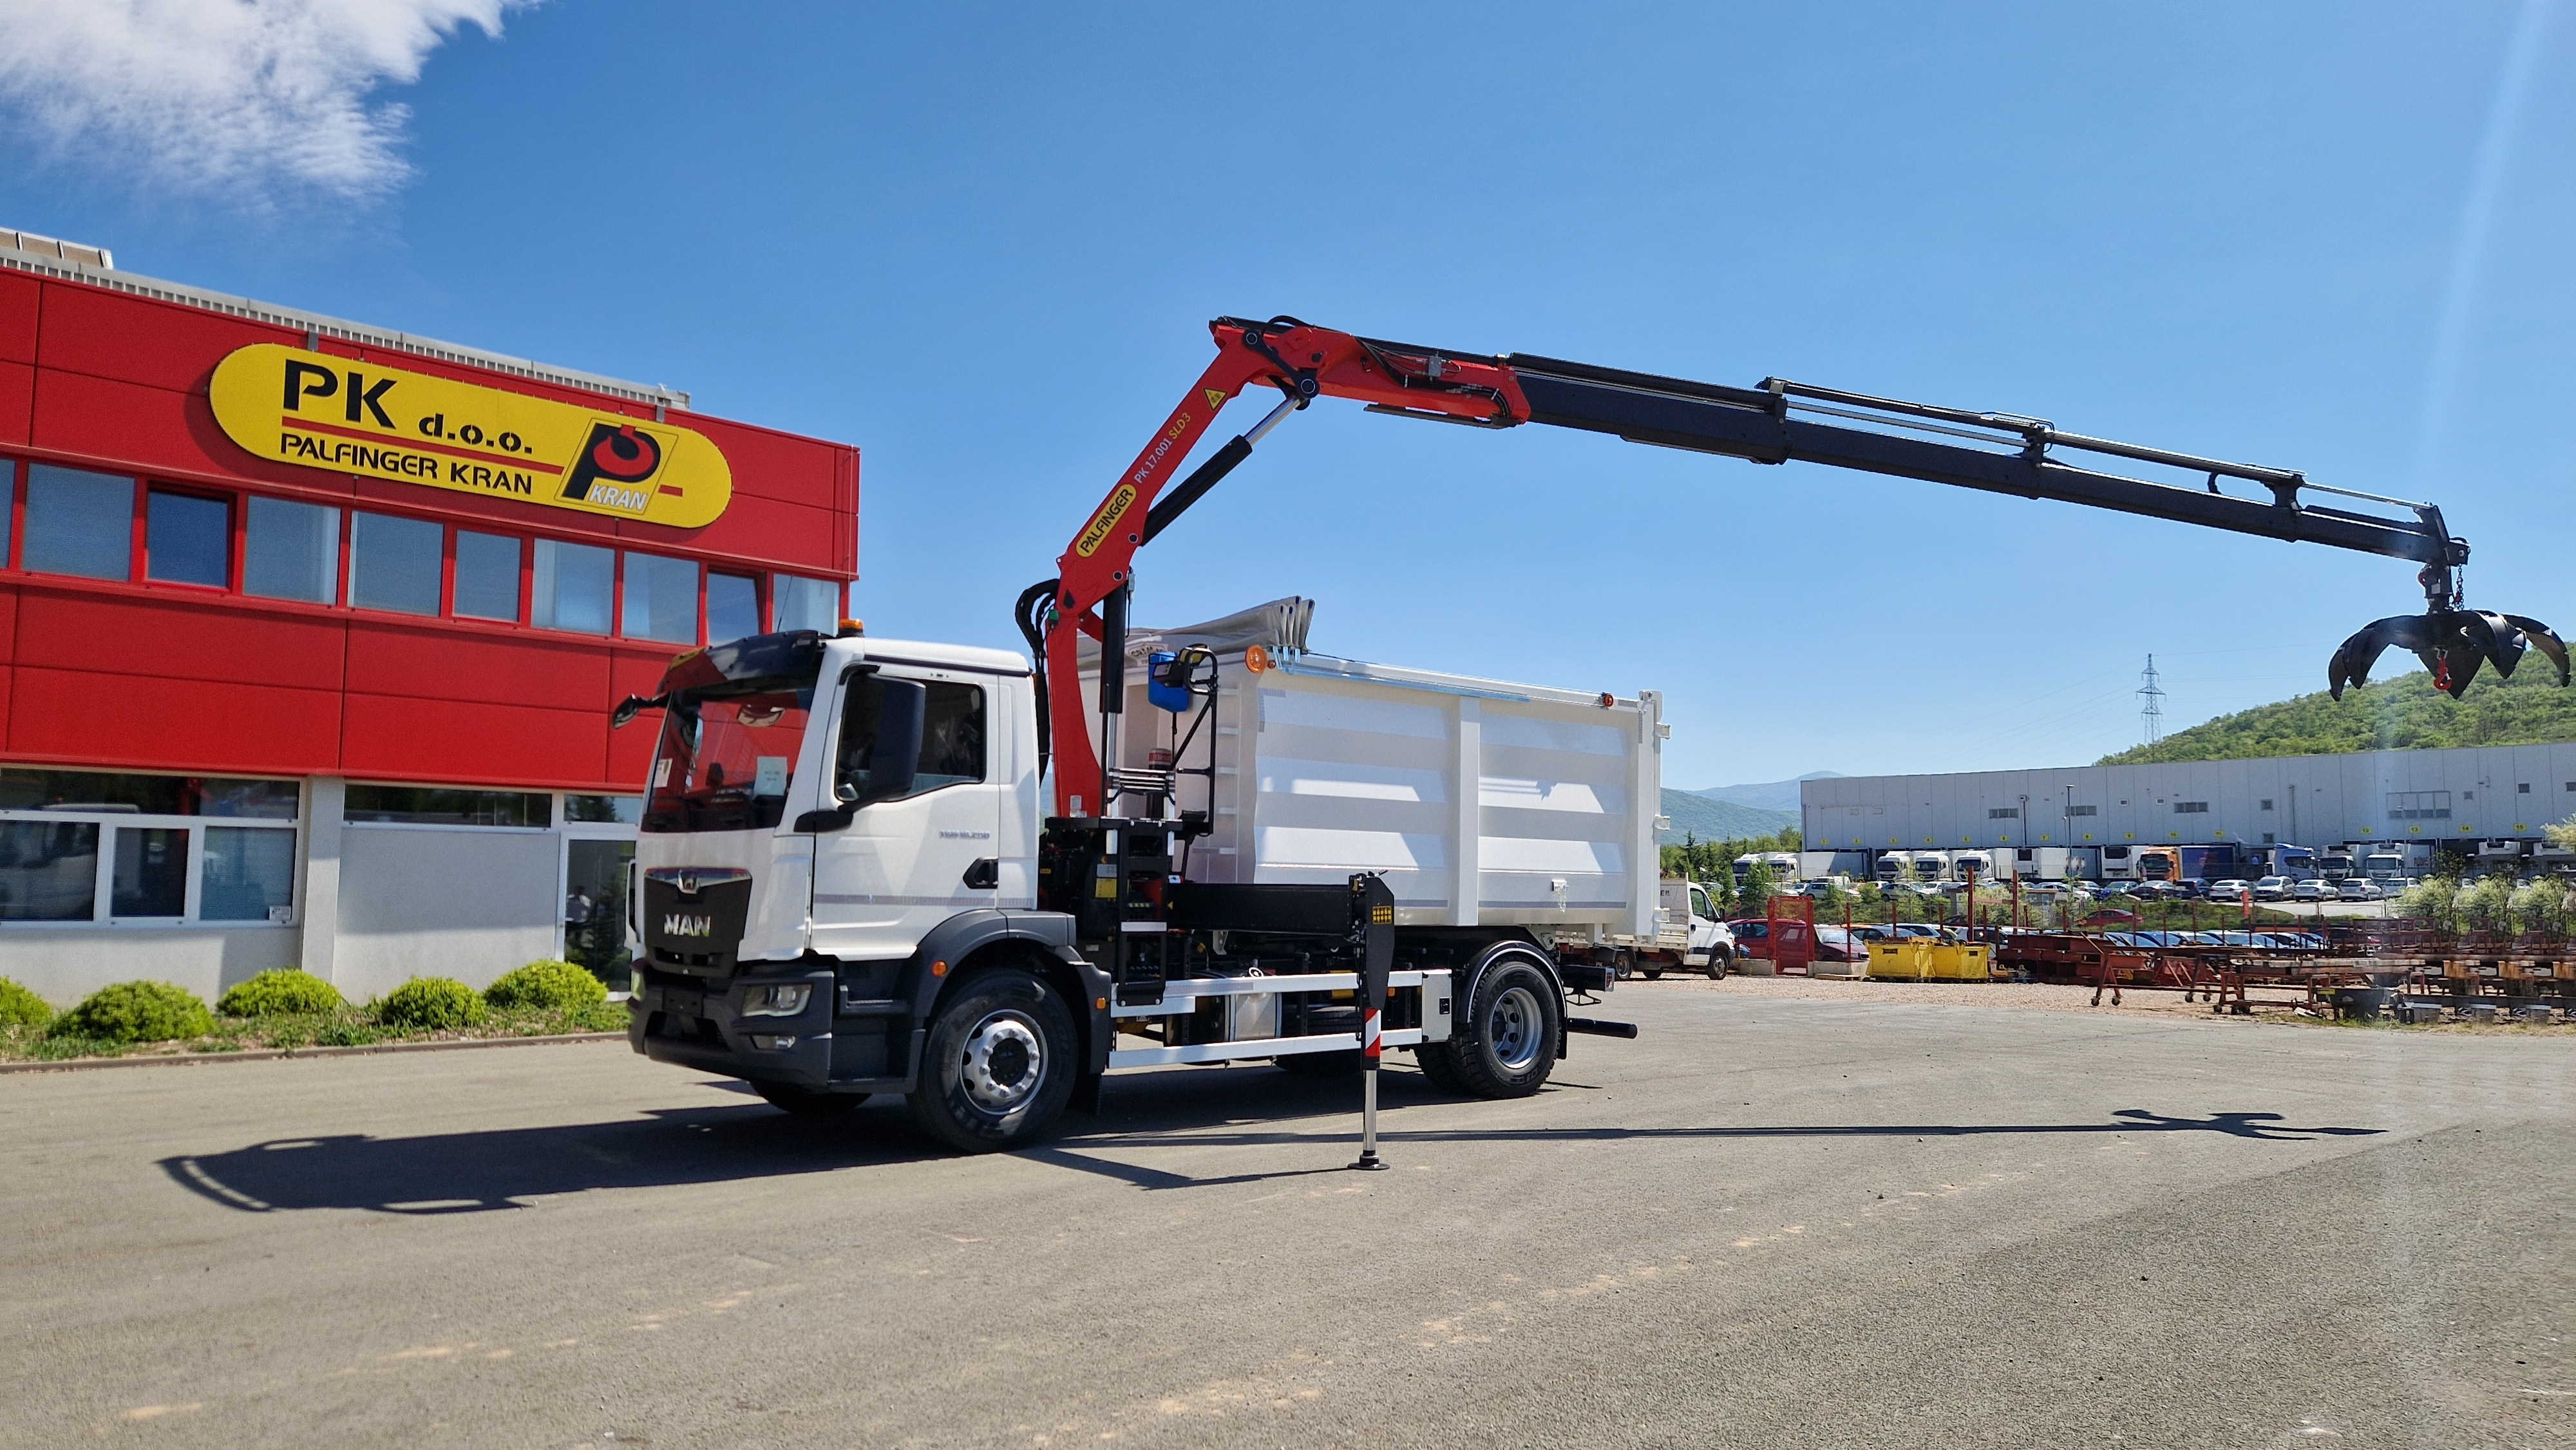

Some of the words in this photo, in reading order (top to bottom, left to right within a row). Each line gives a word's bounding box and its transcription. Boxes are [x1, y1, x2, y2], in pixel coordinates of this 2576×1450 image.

[283, 359, 398, 429] PK
[419, 413, 533, 454] d.o.o.
[281, 433, 438, 480] PALFINGER
[450, 462, 533, 494] KRAN
[1134, 467, 1150, 484] PK
[1145, 437, 1173, 470] 17.001
[589, 484, 647, 511] KRAN
[1079, 488, 1133, 553] PALFINGER
[664, 914, 711, 937] MAN
